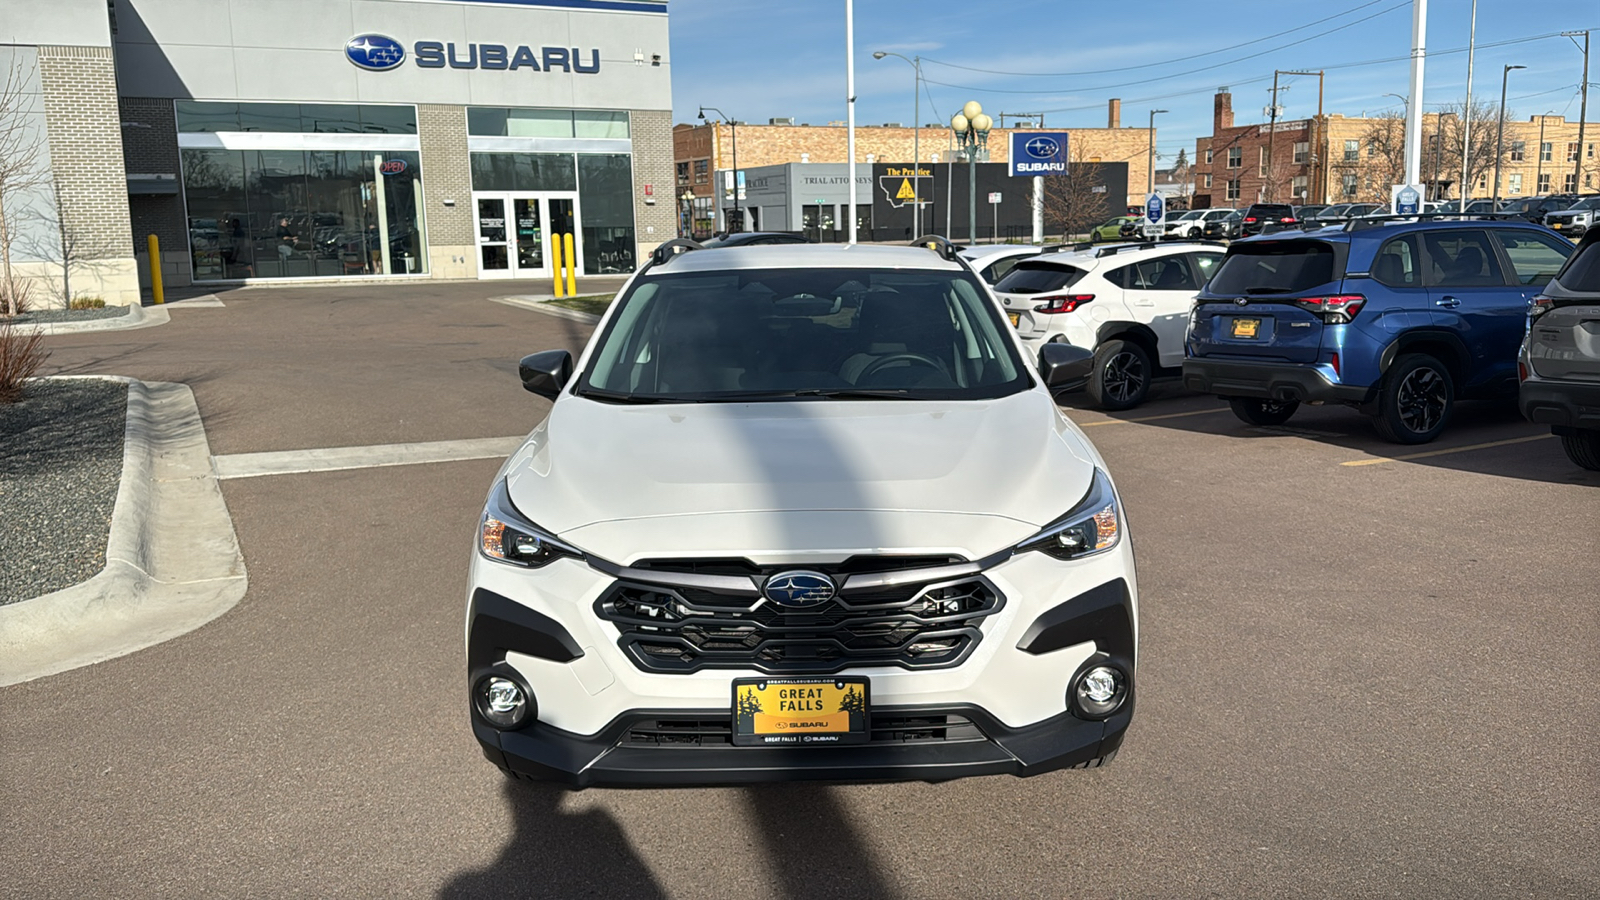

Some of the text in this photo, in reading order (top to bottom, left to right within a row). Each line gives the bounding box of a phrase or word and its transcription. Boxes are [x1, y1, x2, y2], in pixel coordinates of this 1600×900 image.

[414, 41, 600, 74] SUBARU
[380, 162, 405, 173] OPEN
[887, 168, 931, 176] The Pratice
[1017, 163, 1065, 172] SUBARU
[779, 688, 823, 699] GREAT
[780, 700, 823, 711] FALLS
